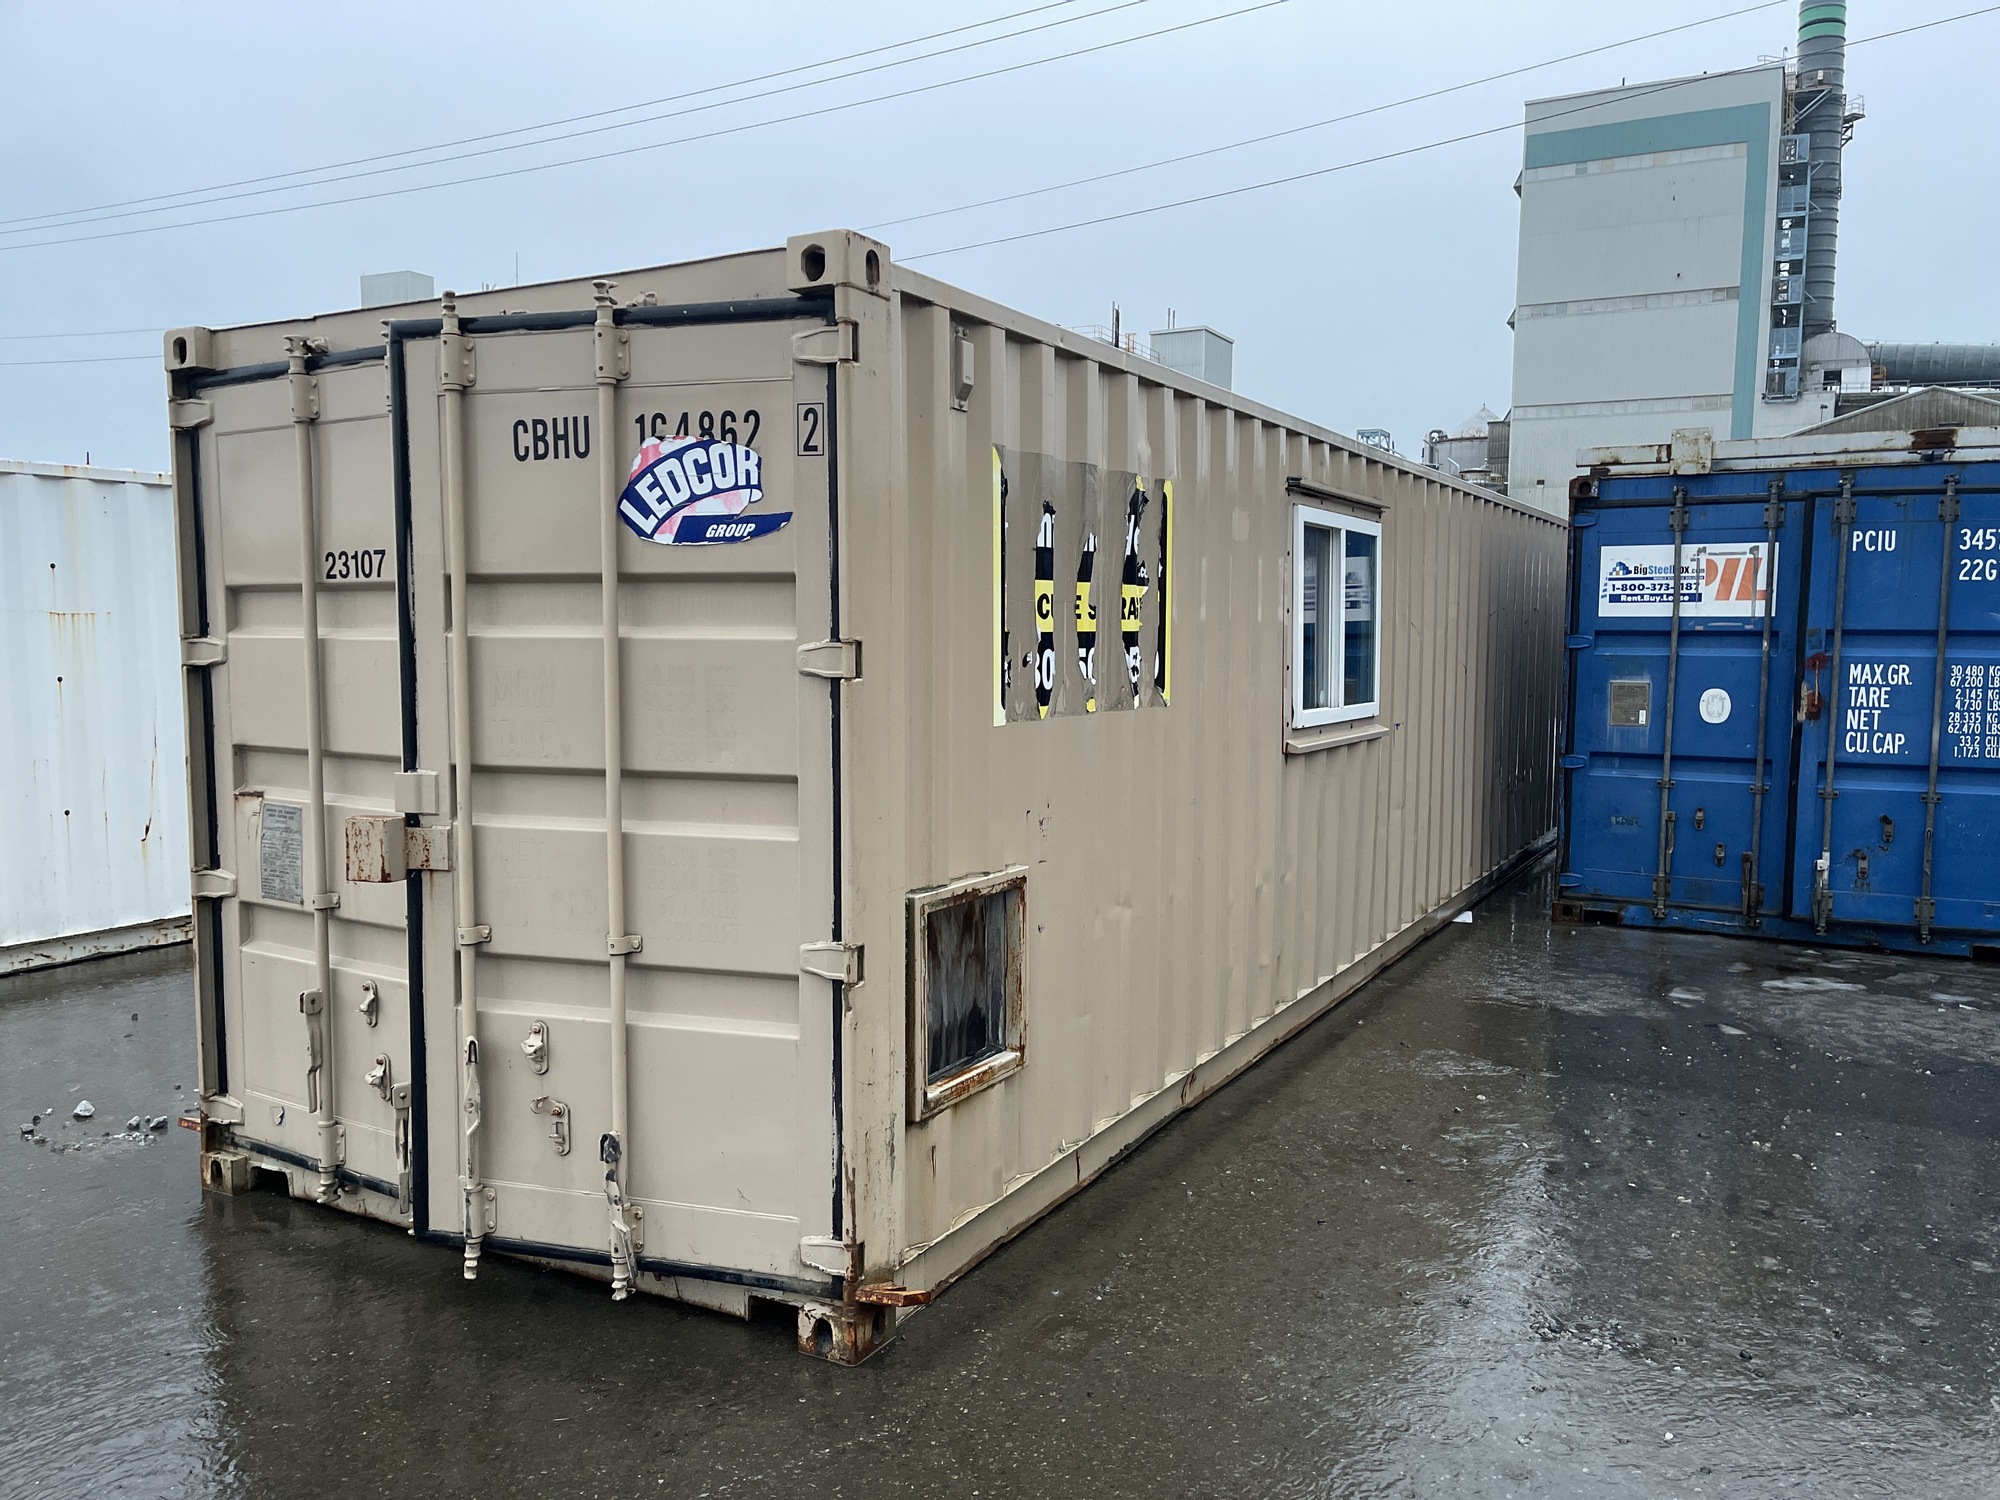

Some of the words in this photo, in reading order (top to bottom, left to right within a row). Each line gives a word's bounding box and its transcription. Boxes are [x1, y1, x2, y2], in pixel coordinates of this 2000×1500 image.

[513, 415, 590, 461] CBHU
[802, 406, 819, 452] 2
[619, 442, 759, 535] LEDCOR
[705, 523, 756, 538] GROUP
[1852, 529, 1897, 552] PCIU
[325, 549, 386, 579] 23107
[1950, 665, 1984, 677] 30,480
[1950, 676, 1983, 688] 67,200
[1848, 686, 1891, 708] TARE
[1987, 689, 1999, 701] KG
[1846, 709, 1882, 731] NET
[1986, 712, 1999, 724] KG
